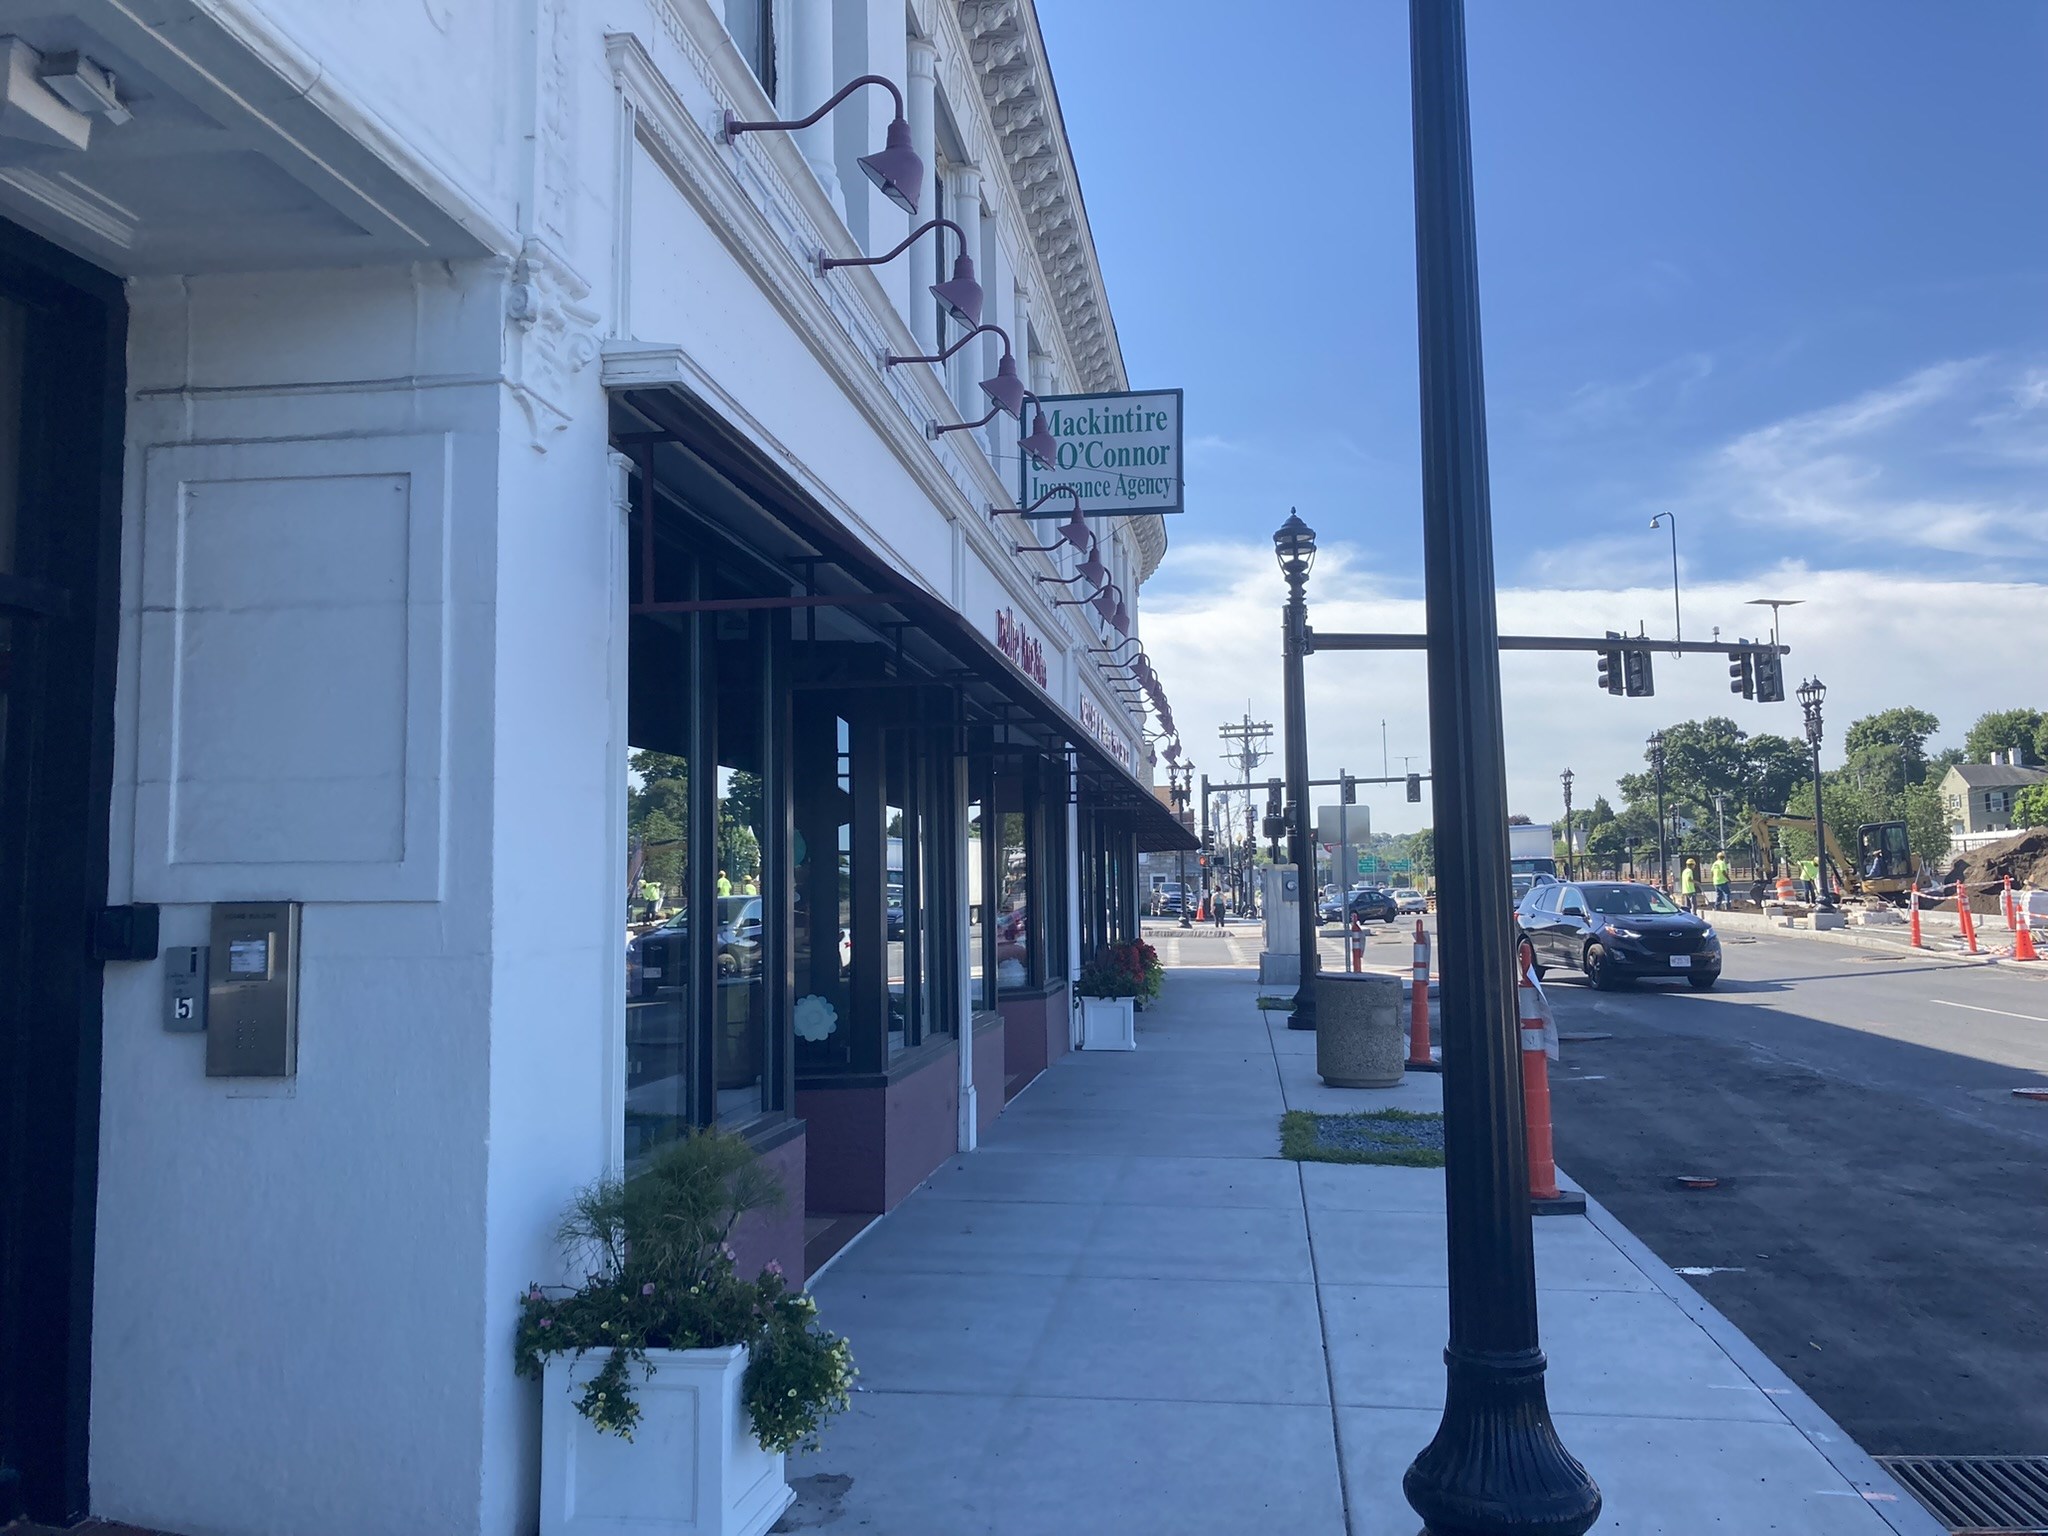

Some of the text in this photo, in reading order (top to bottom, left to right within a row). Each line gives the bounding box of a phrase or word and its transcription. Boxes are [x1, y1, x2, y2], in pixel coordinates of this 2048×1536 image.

[1057, 441, 1170, 470] O'Connor
[1032, 473, 1172, 500] Insurance Agency
[178, 997, 190, 1018] 5
